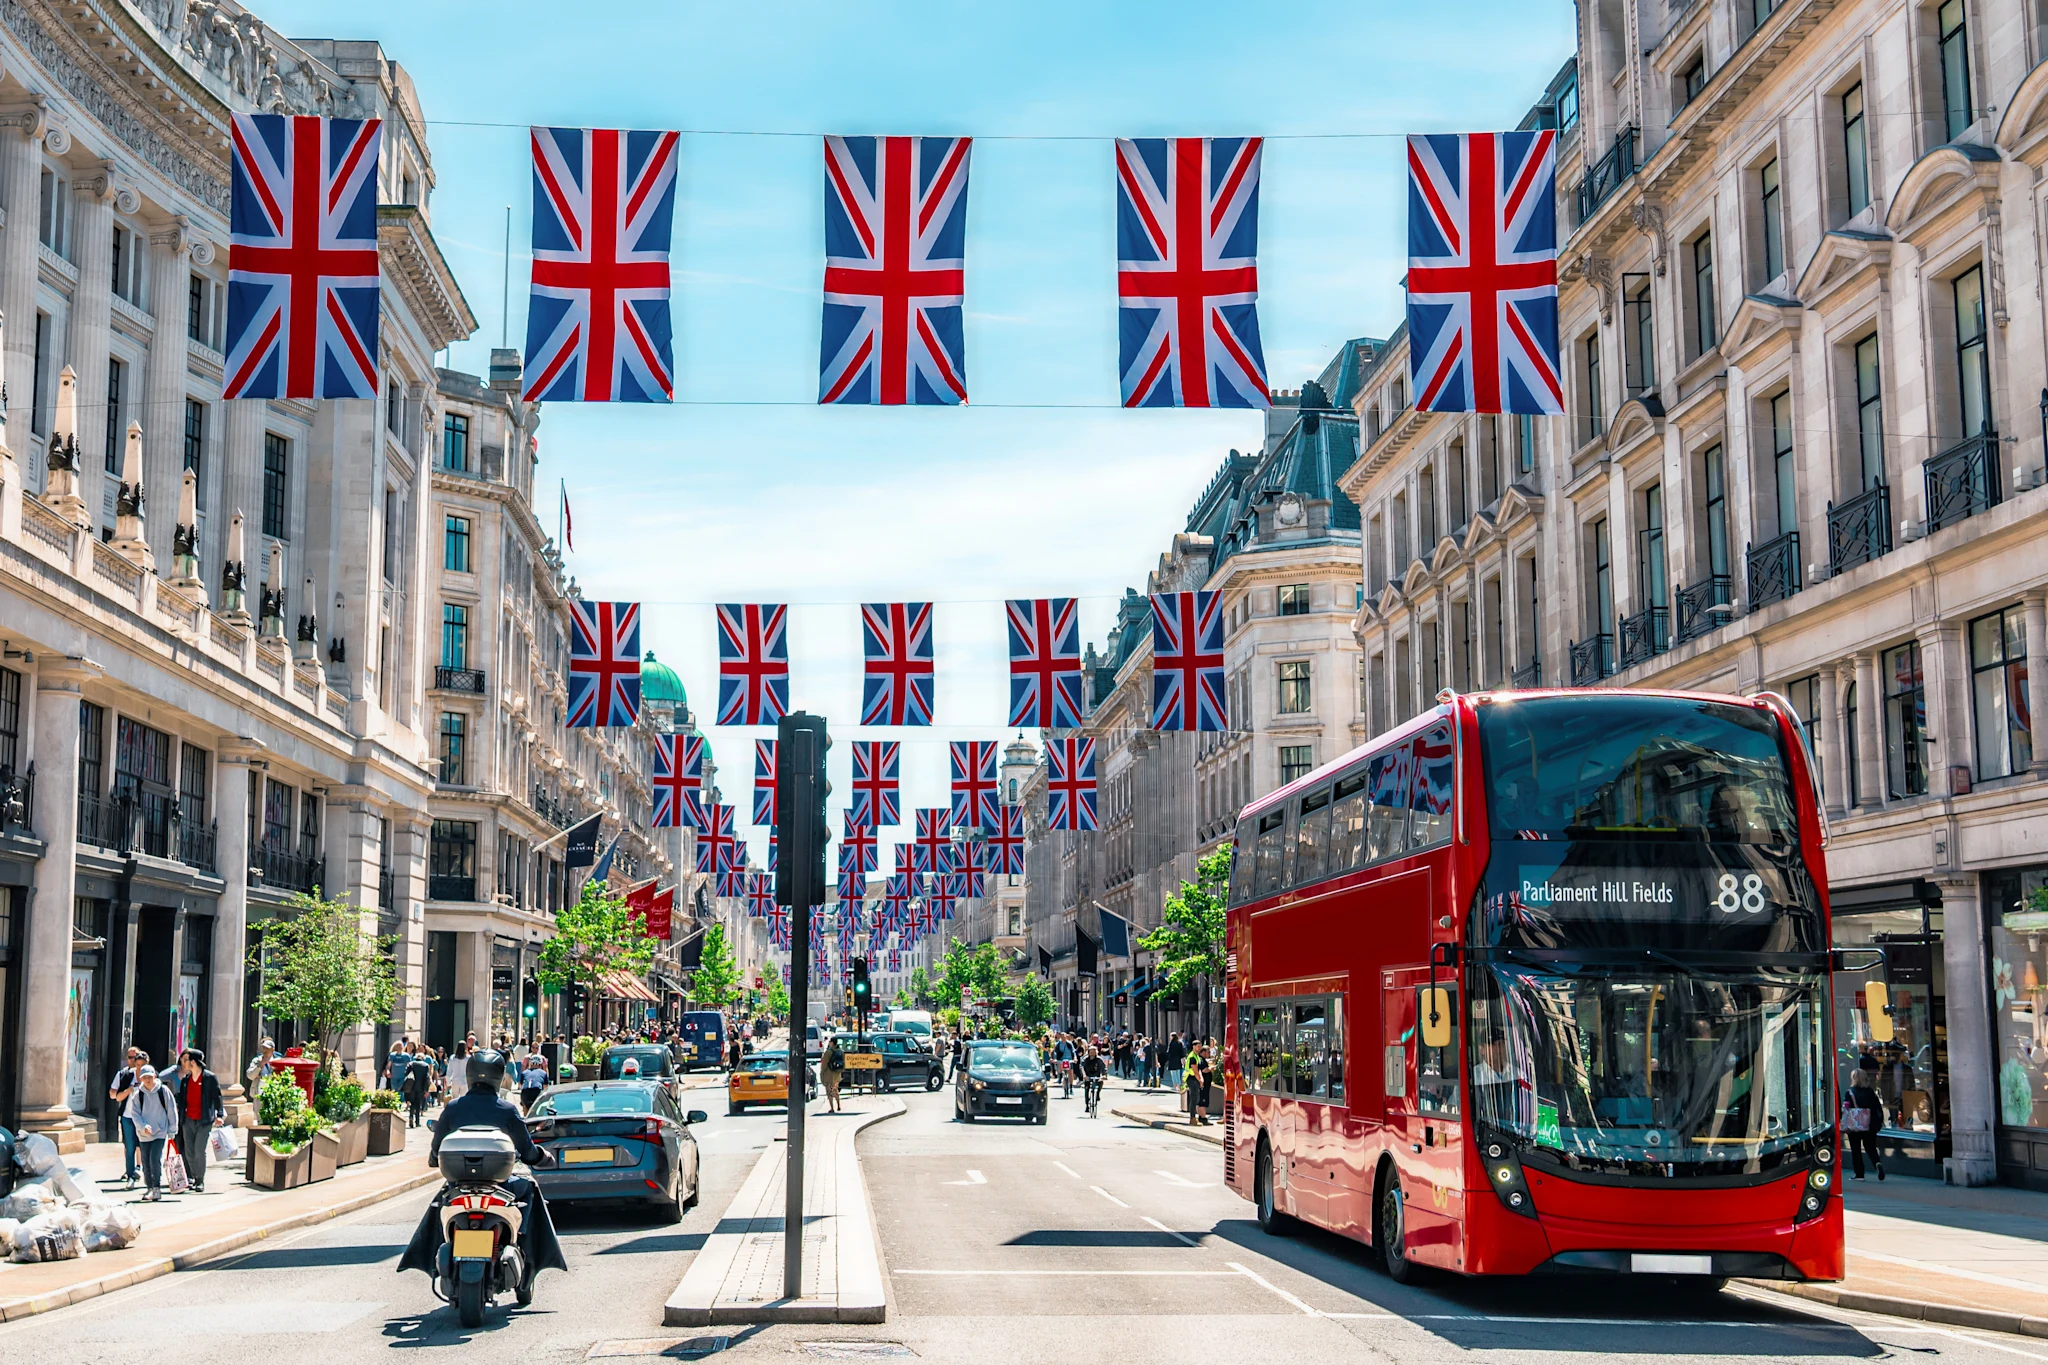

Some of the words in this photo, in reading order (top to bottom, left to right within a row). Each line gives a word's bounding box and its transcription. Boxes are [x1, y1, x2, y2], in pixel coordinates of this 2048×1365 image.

[1523, 880, 1598, 903] Parliament
[1603, 881, 1628, 903] Hill
[1633, 882, 1673, 904] Fields
[1717, 873, 1765, 914] 88
